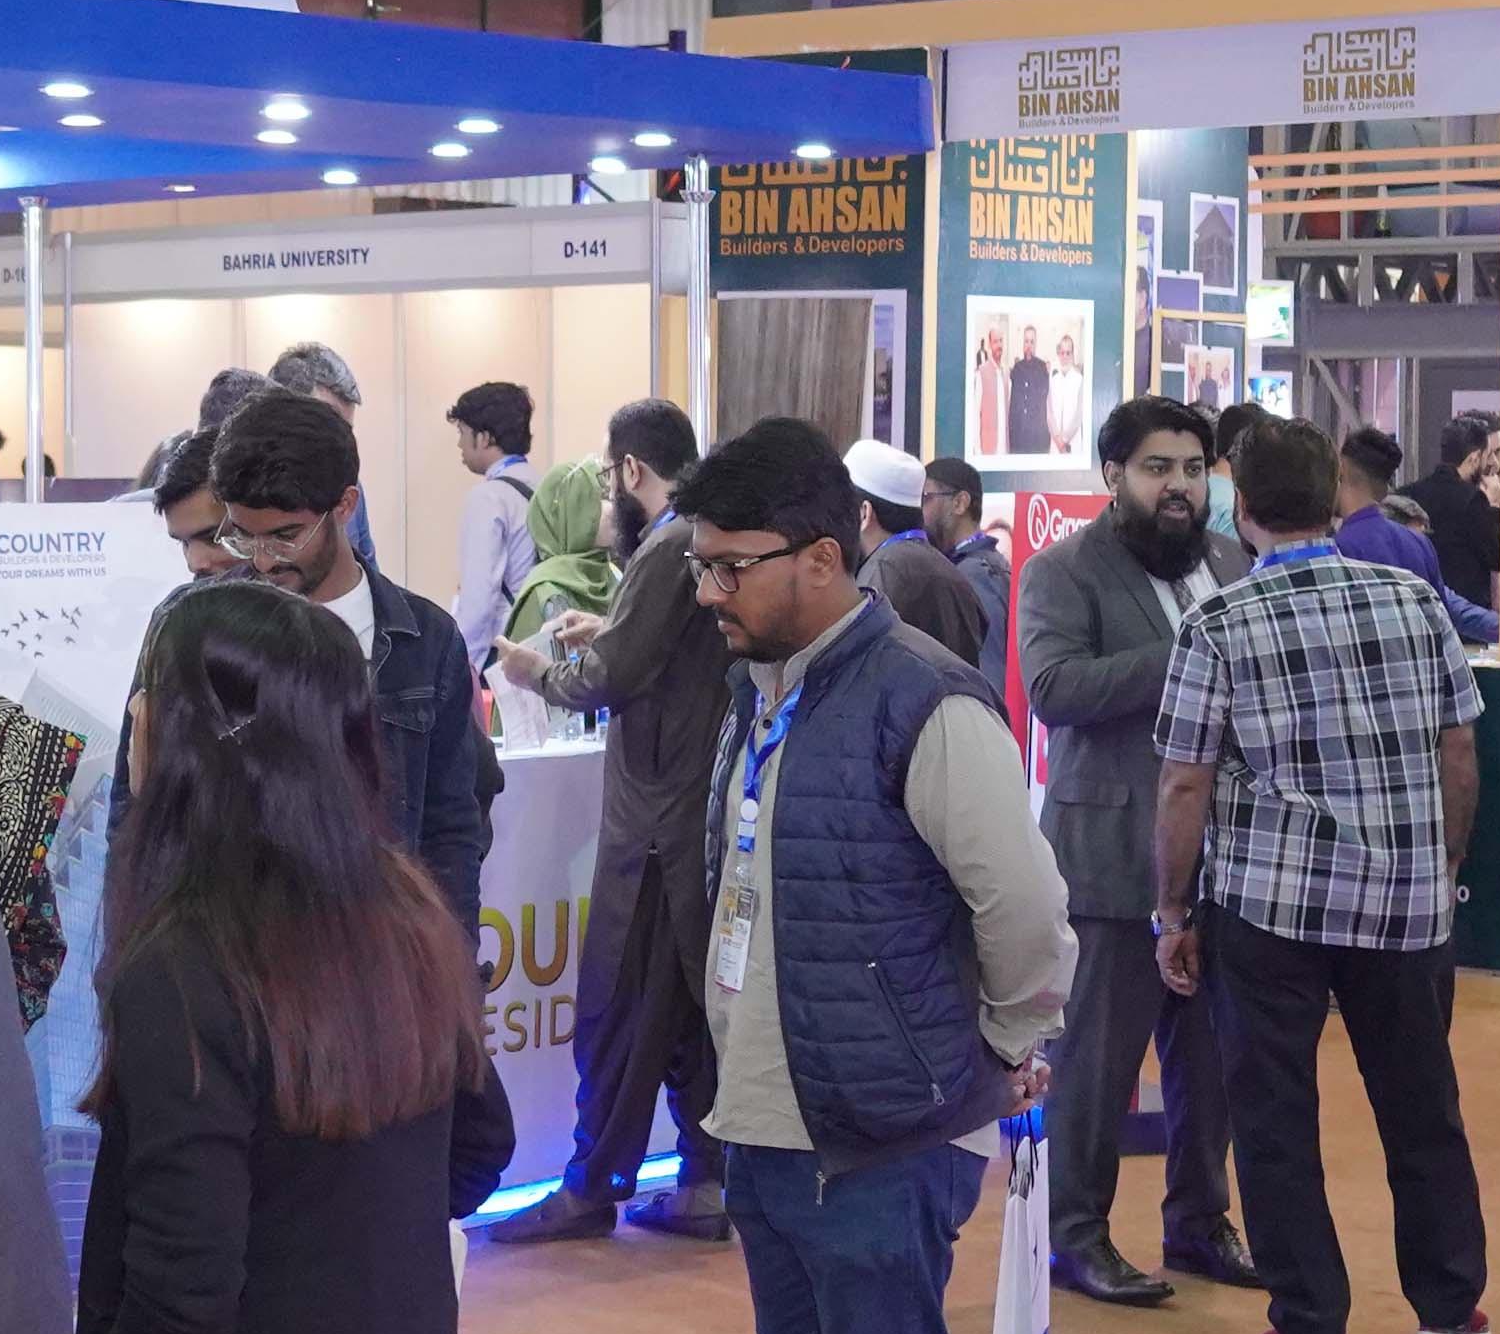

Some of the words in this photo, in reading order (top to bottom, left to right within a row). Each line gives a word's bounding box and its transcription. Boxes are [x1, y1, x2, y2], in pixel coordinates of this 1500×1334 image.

[1303, 76, 1338, 102] BIN
[1344, 72, 1415, 100] AHSAN
[1018, 92, 1050, 117] BIN
[1056, 89, 1120, 115] AHSAN
[1357, 99, 1415, 112] Developers
[1018, 118, 1057, 128] Builders
[1067, 115, 1120, 127] Developers
[720, 188, 779, 235] BIN
[787, 185, 906, 234] AHSAN
[969, 192, 1010, 240] BIN
[1015, 195, 1093, 245] AHSAN
[564, 240, 607, 258] D-141
[720, 237, 788, 256] Builders
[794, 237, 805, 254] &
[809, 234, 905, 257] Developers
[969, 240, 1017, 261] Builders
[1020, 243, 1029, 261] &
[1031, 244, 1092, 267] Developers
[223, 252, 276, 271] BAHRIA
[281, 248, 370, 268] UNIVERSITY
[49, 552, 106, 564] DEVELOPERS
[25, 567, 65, 579] DREAMS
[67, 567, 92, 578] WITH
[94, 566, 106, 577] US
